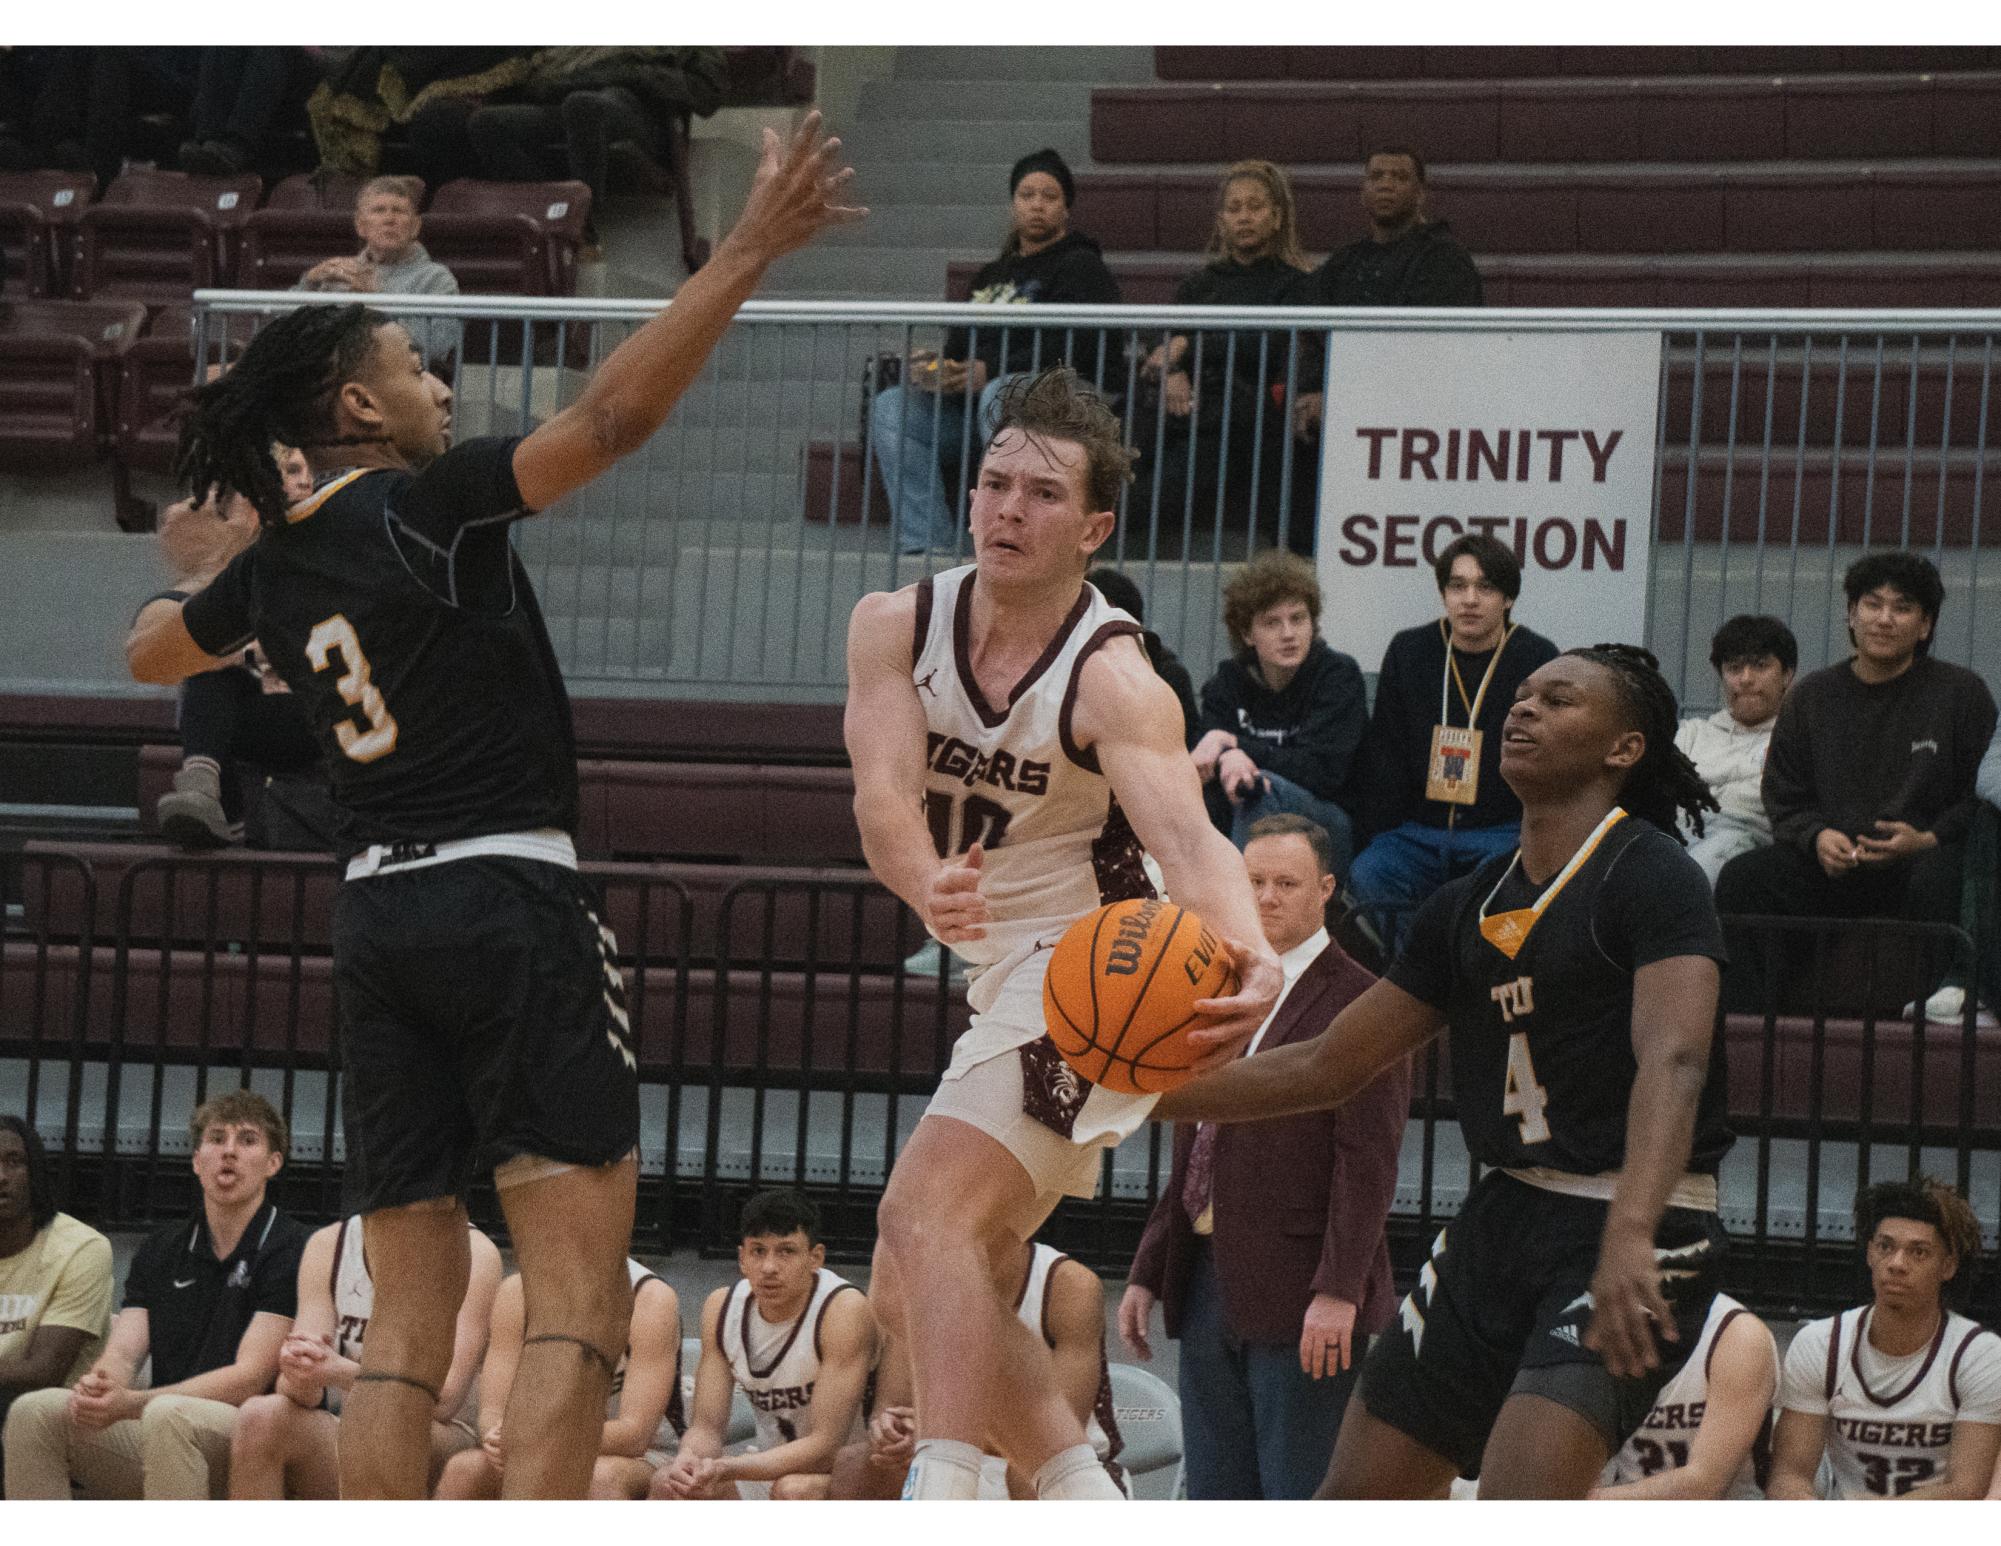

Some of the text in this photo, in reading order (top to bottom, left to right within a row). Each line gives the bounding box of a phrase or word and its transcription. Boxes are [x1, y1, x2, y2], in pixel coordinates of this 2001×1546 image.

[1356, 427, 1624, 483] TRINITY
[305, 612, 399, 765] 3
[927, 731, 1050, 796] IGERS
[1491, 975, 1534, 1023] TU
[1503, 1031, 1552, 1145] 4
[1833, 1417, 1953, 1448] TIGERS
[1857, 1452, 1935, 1497] 32
